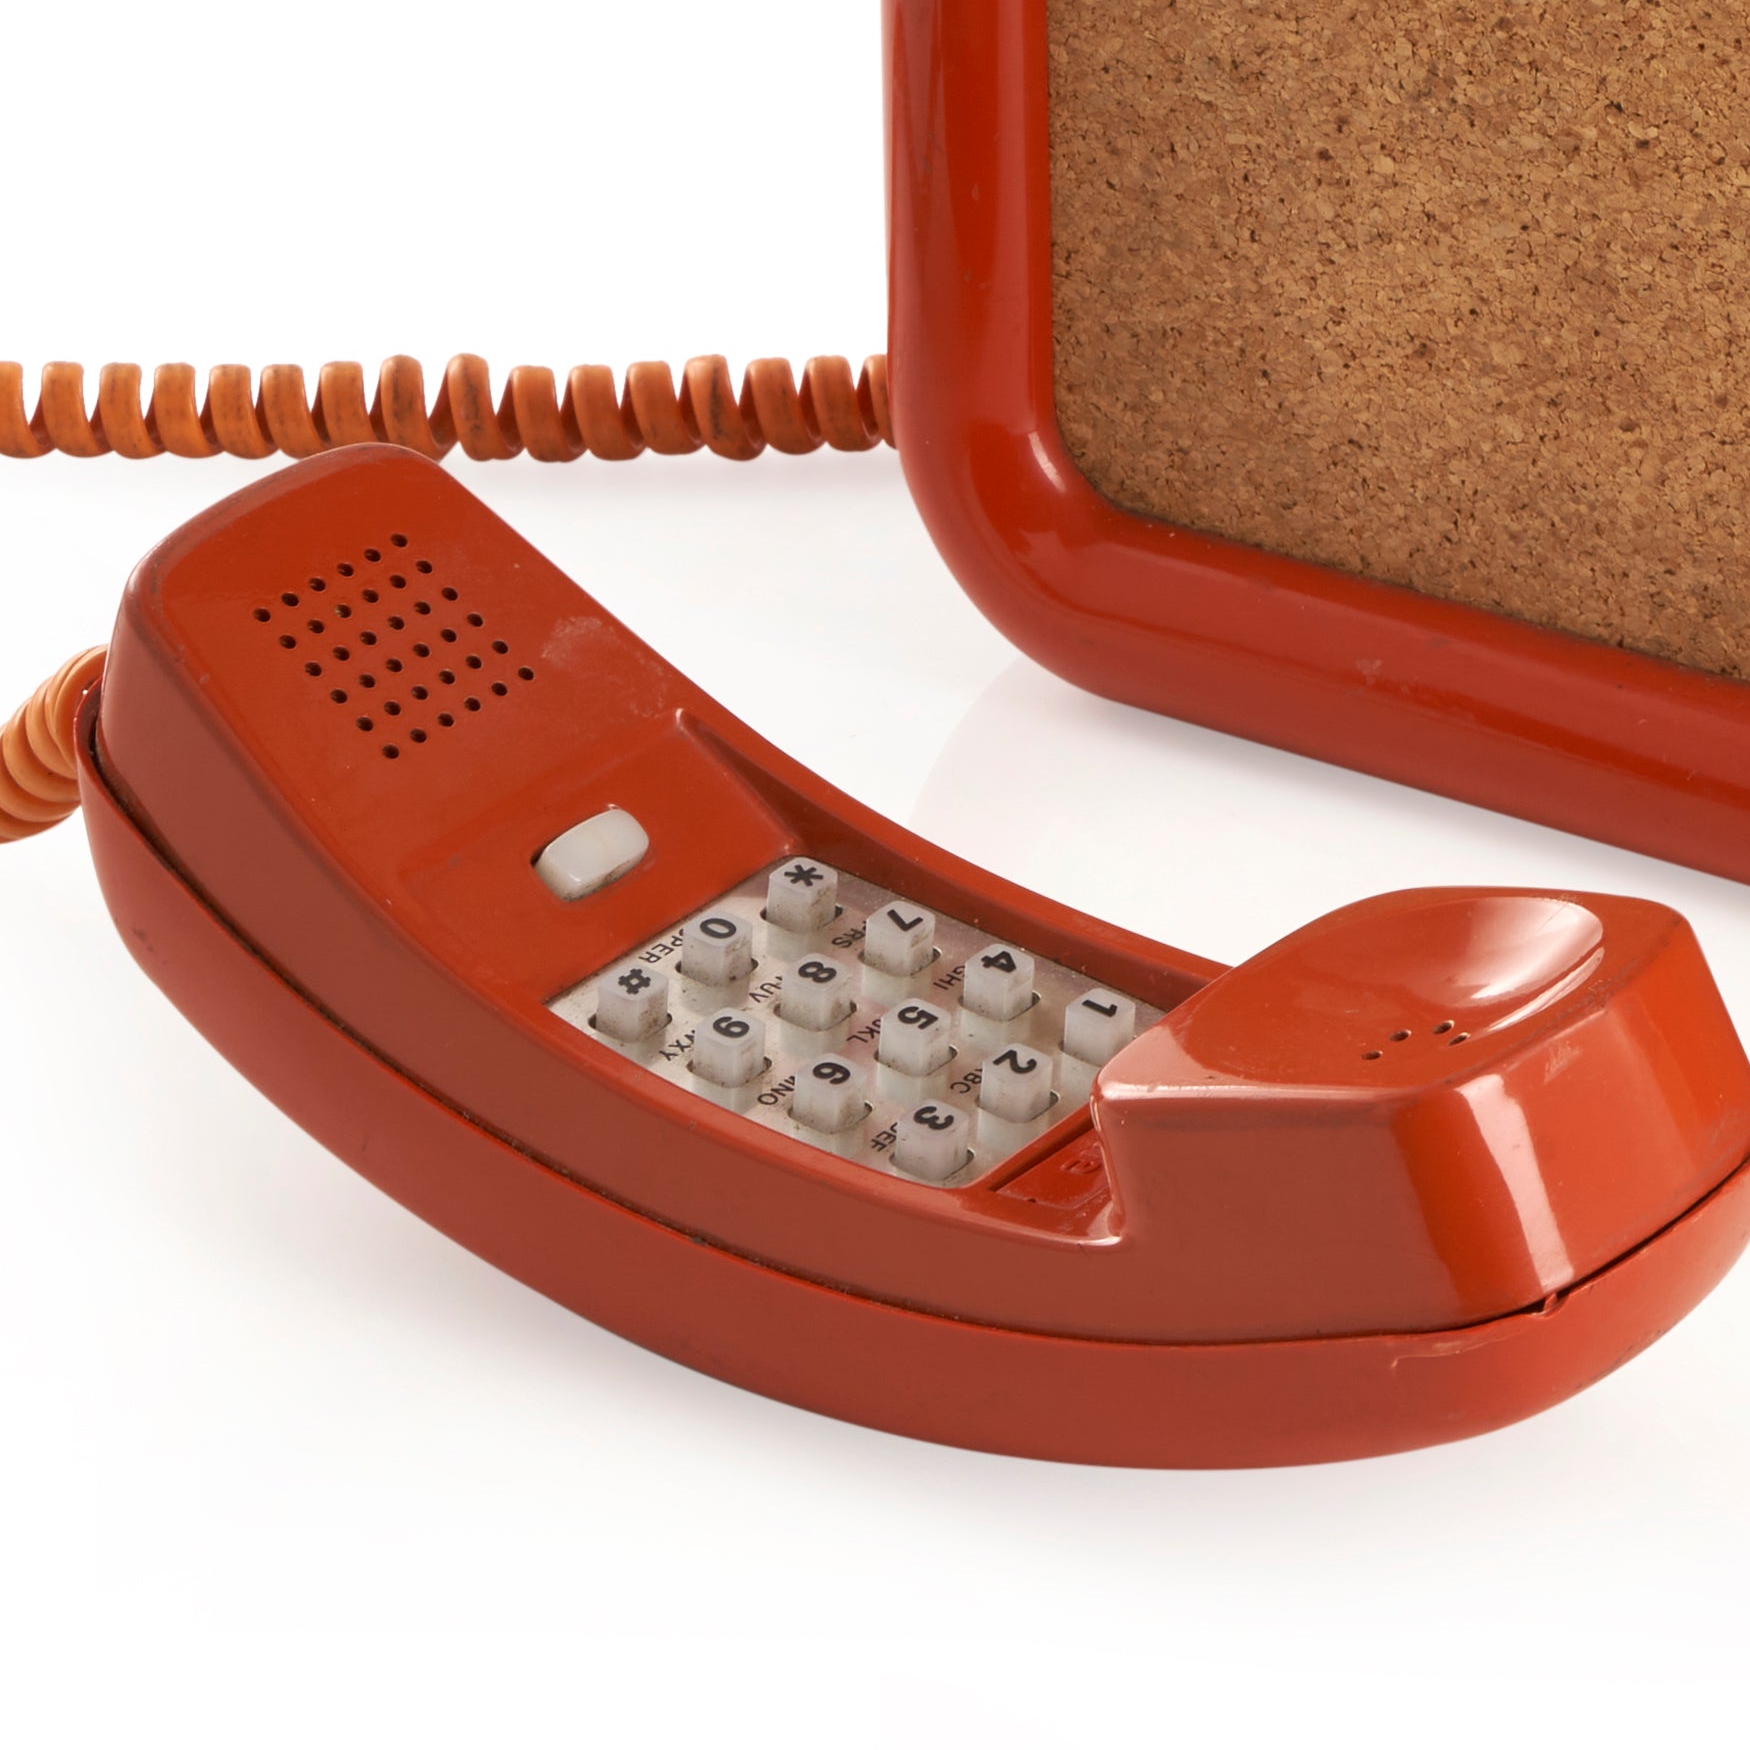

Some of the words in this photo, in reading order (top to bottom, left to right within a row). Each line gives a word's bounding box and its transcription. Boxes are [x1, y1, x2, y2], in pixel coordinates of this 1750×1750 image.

[700, 917, 737, 939] 0
[887, 909, 923, 931] 7
[798, 961, 837, 983] 8
[981, 950, 1017, 973] 4
[898, 1006, 939, 1030] 5
[1082, 999, 1118, 1018] 1
[713, 1016, 750, 1038] 9
[813, 1061, 851, 1084] 6
[993, 1049, 1038, 1074] 2
[913, 1105, 955, 1131] 3
